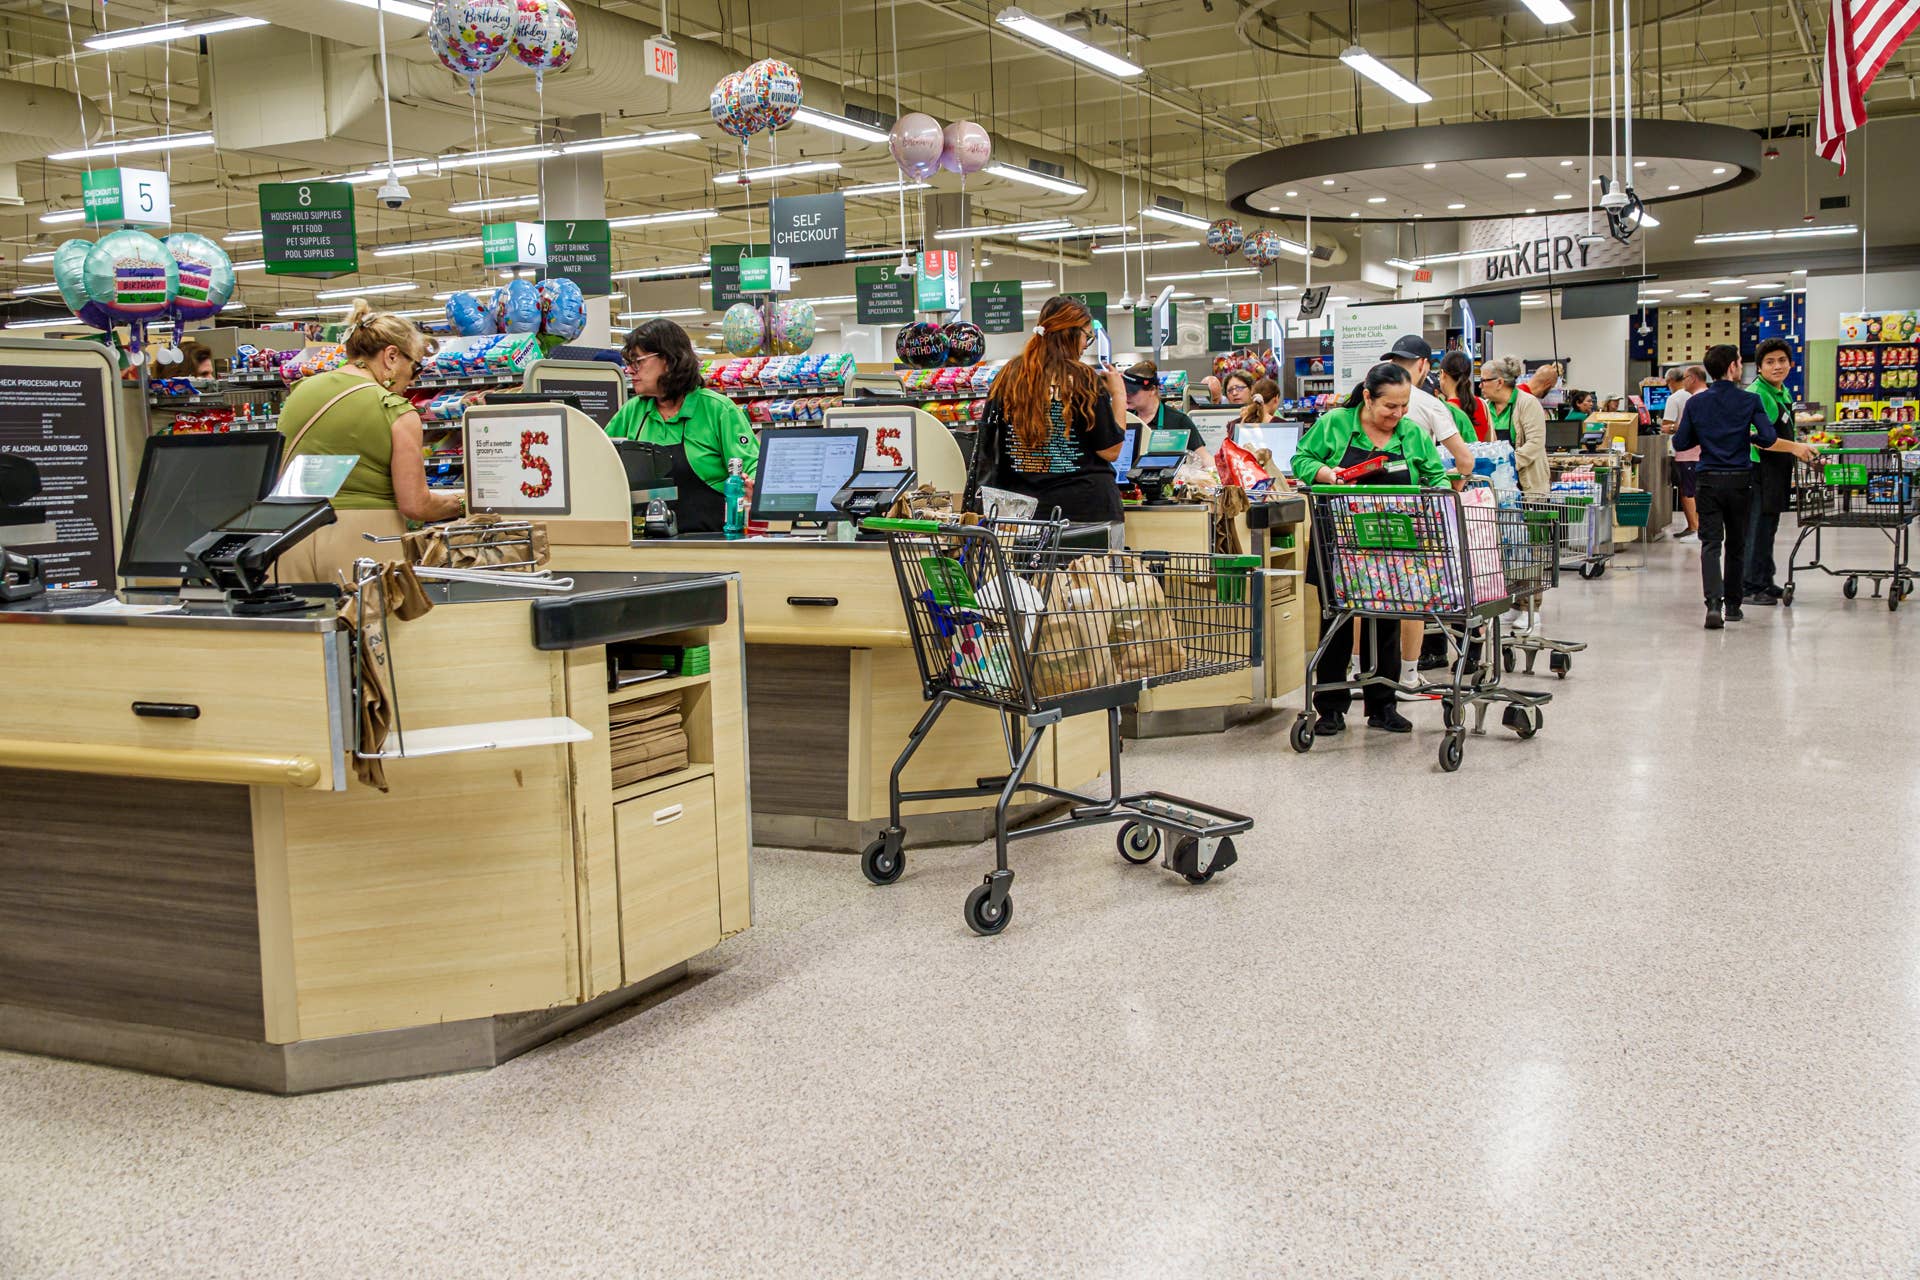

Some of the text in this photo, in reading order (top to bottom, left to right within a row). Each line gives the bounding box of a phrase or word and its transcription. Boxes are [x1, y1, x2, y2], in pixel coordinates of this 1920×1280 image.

[464, 6, 512, 30] Birthday
[655, 47, 673, 76] EXIT
[139, 183, 153, 212] 5
[299, 186, 311, 206] 8
[271, 210, 342, 221] HOUSEHOLD SUPPLIES
[793, 213, 822, 227] SELF
[292, 224, 322, 233] PET FOOD
[565, 222, 576, 240] 7
[286, 236, 331, 246] PET SUPPLIES
[777, 228, 839, 244] CHECKOUT
[528, 233, 536, 256] 6
[285, 249, 335, 258] POOL SUPPLIES
[1486, 234, 1591, 281] BAKERY
[777, 266, 783, 285] 7
[881, 267, 888, 281] 5
[1415, 270, 1430, 281] EXIT
[123, 281, 161, 289] BIRTHDAY
[993, 283, 1000, 295] 4
[1080, 294, 1087, 305] 3
[910, 335, 934, 346] HAPPY
[951, 332, 979, 343] HAPPY
[18, 379, 58, 387] PROCESSING
[60, 380, 82, 388] POLICY
[876, 426, 902, 466] 5
[520, 430, 552, 500] 5
